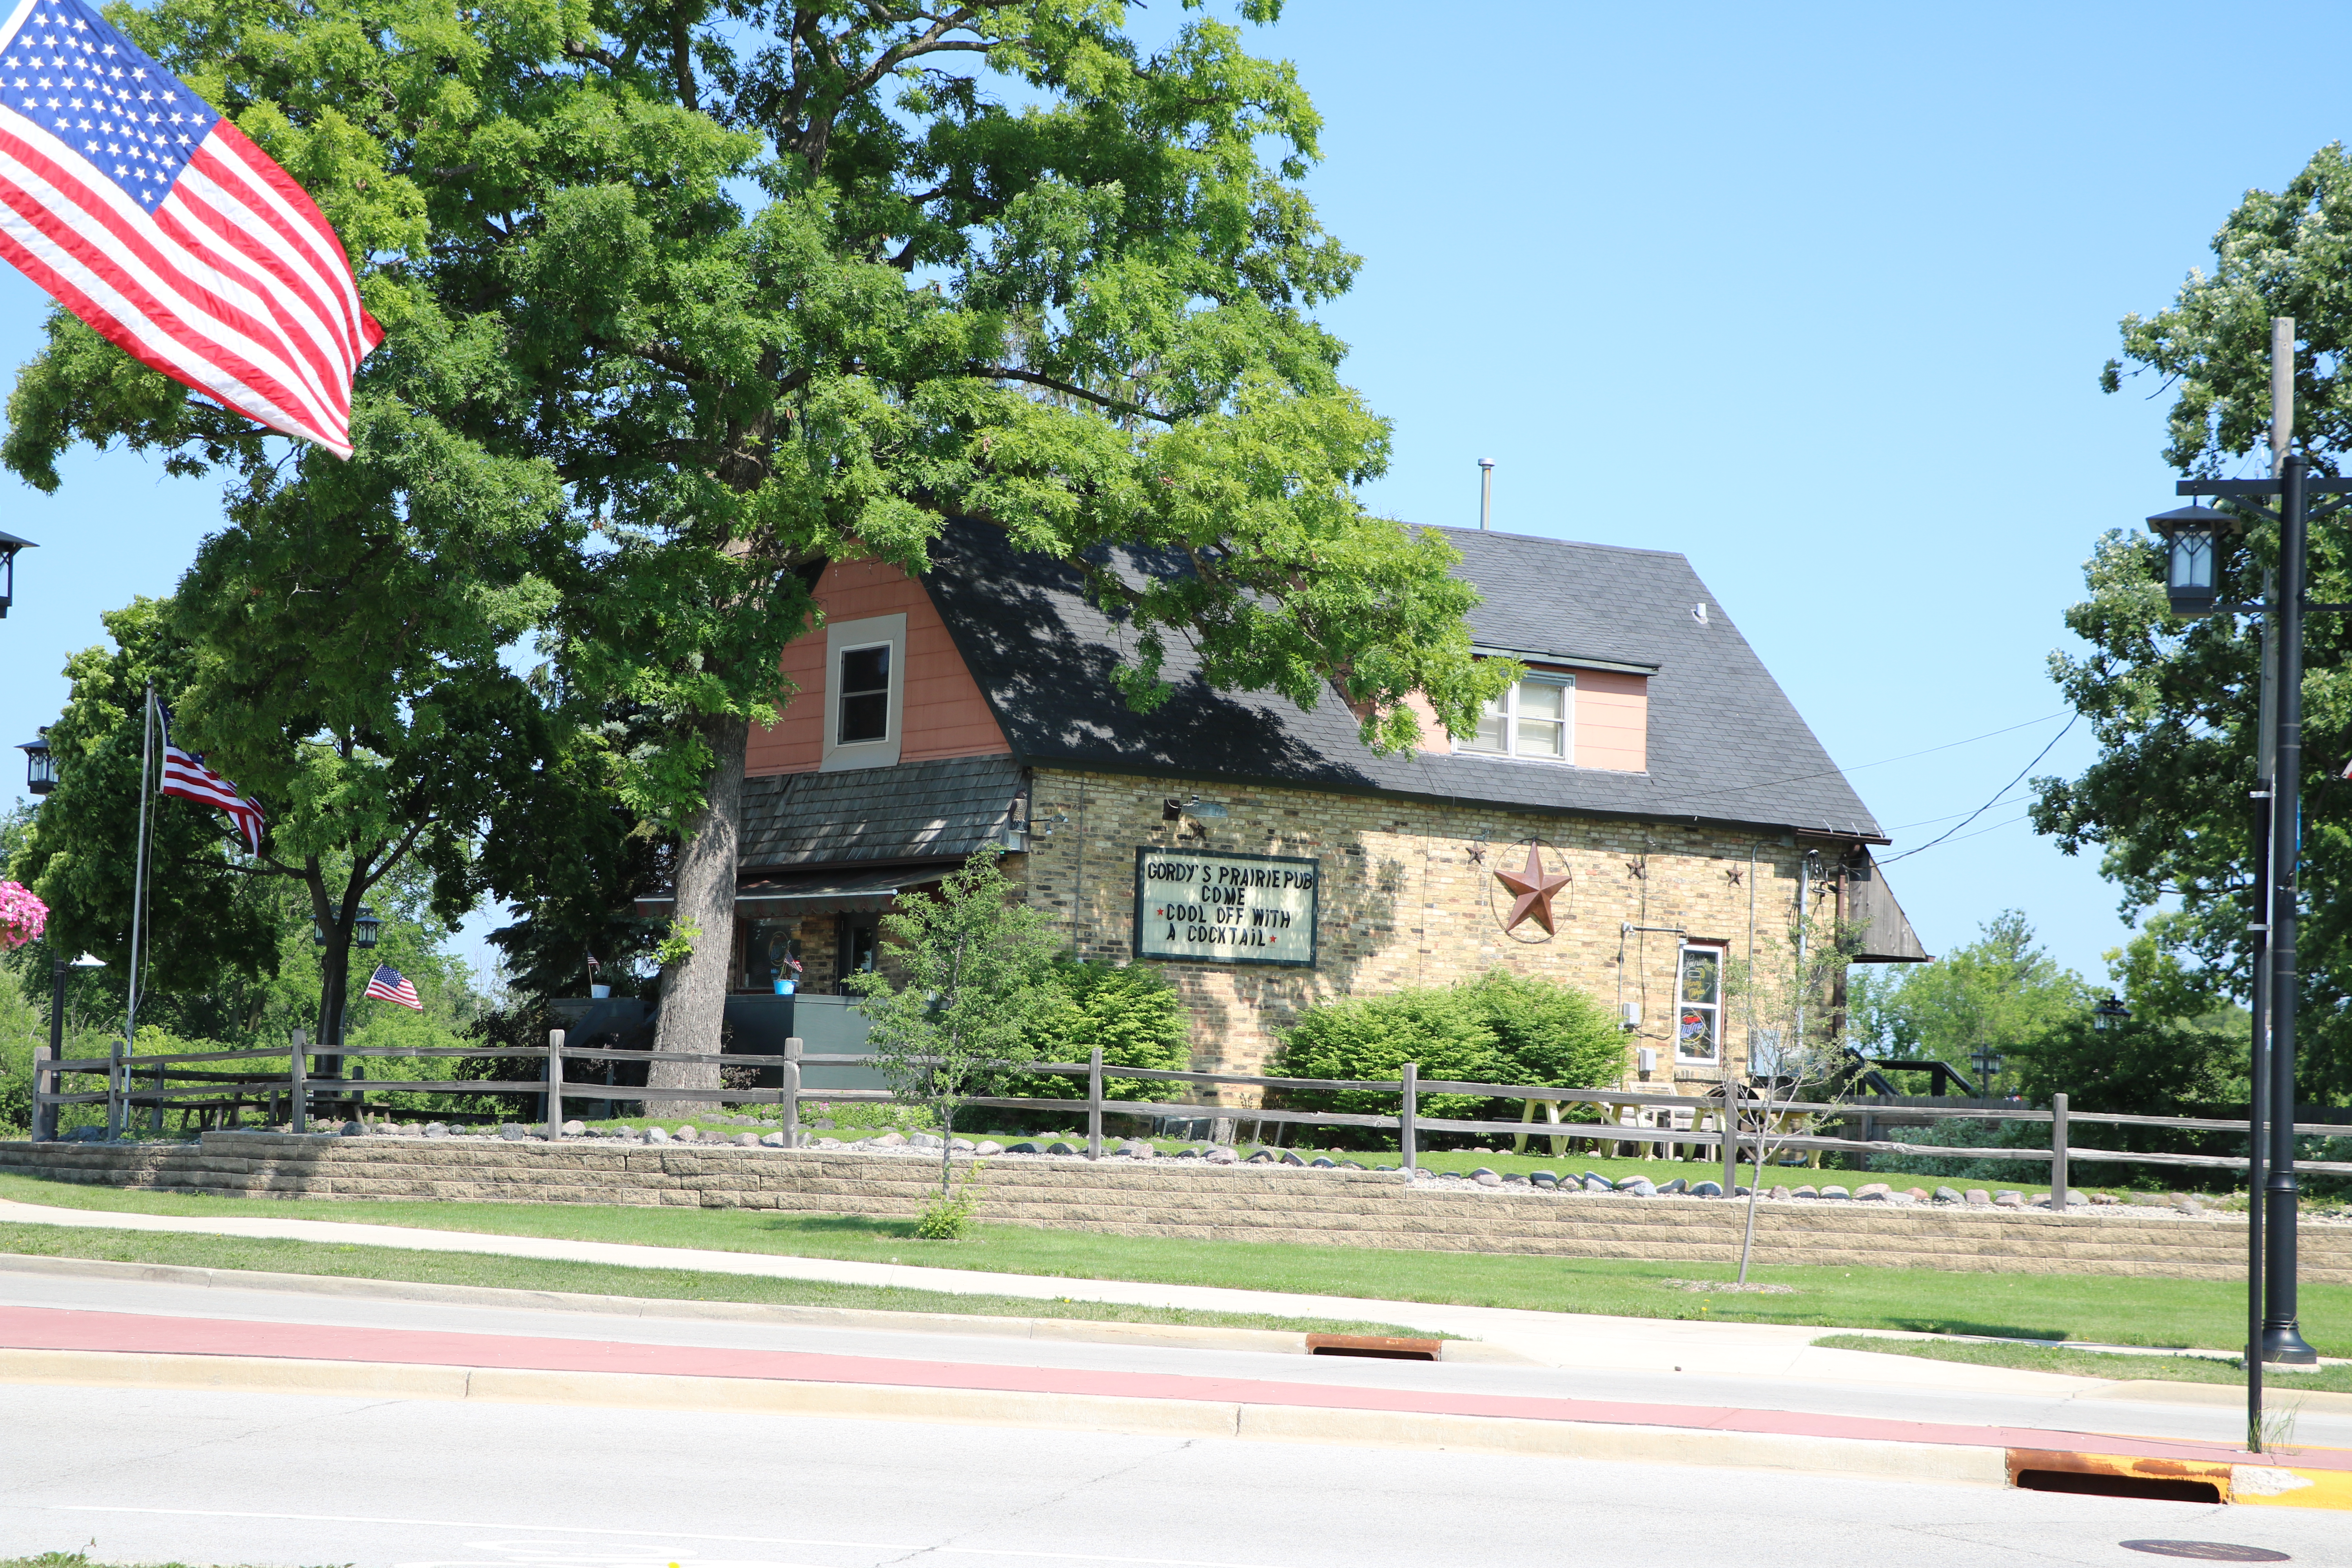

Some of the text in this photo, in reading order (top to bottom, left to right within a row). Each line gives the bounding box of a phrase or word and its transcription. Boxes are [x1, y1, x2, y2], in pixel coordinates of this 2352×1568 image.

[1148, 862, 1313, 889] GORDY'S PRAIRIE PUB
[1202, 885, 1245, 905] COME
[1167, 904, 1207, 923] COOL
[1217, 907, 1244, 925] OFF
[1166, 923, 1176, 940] A
